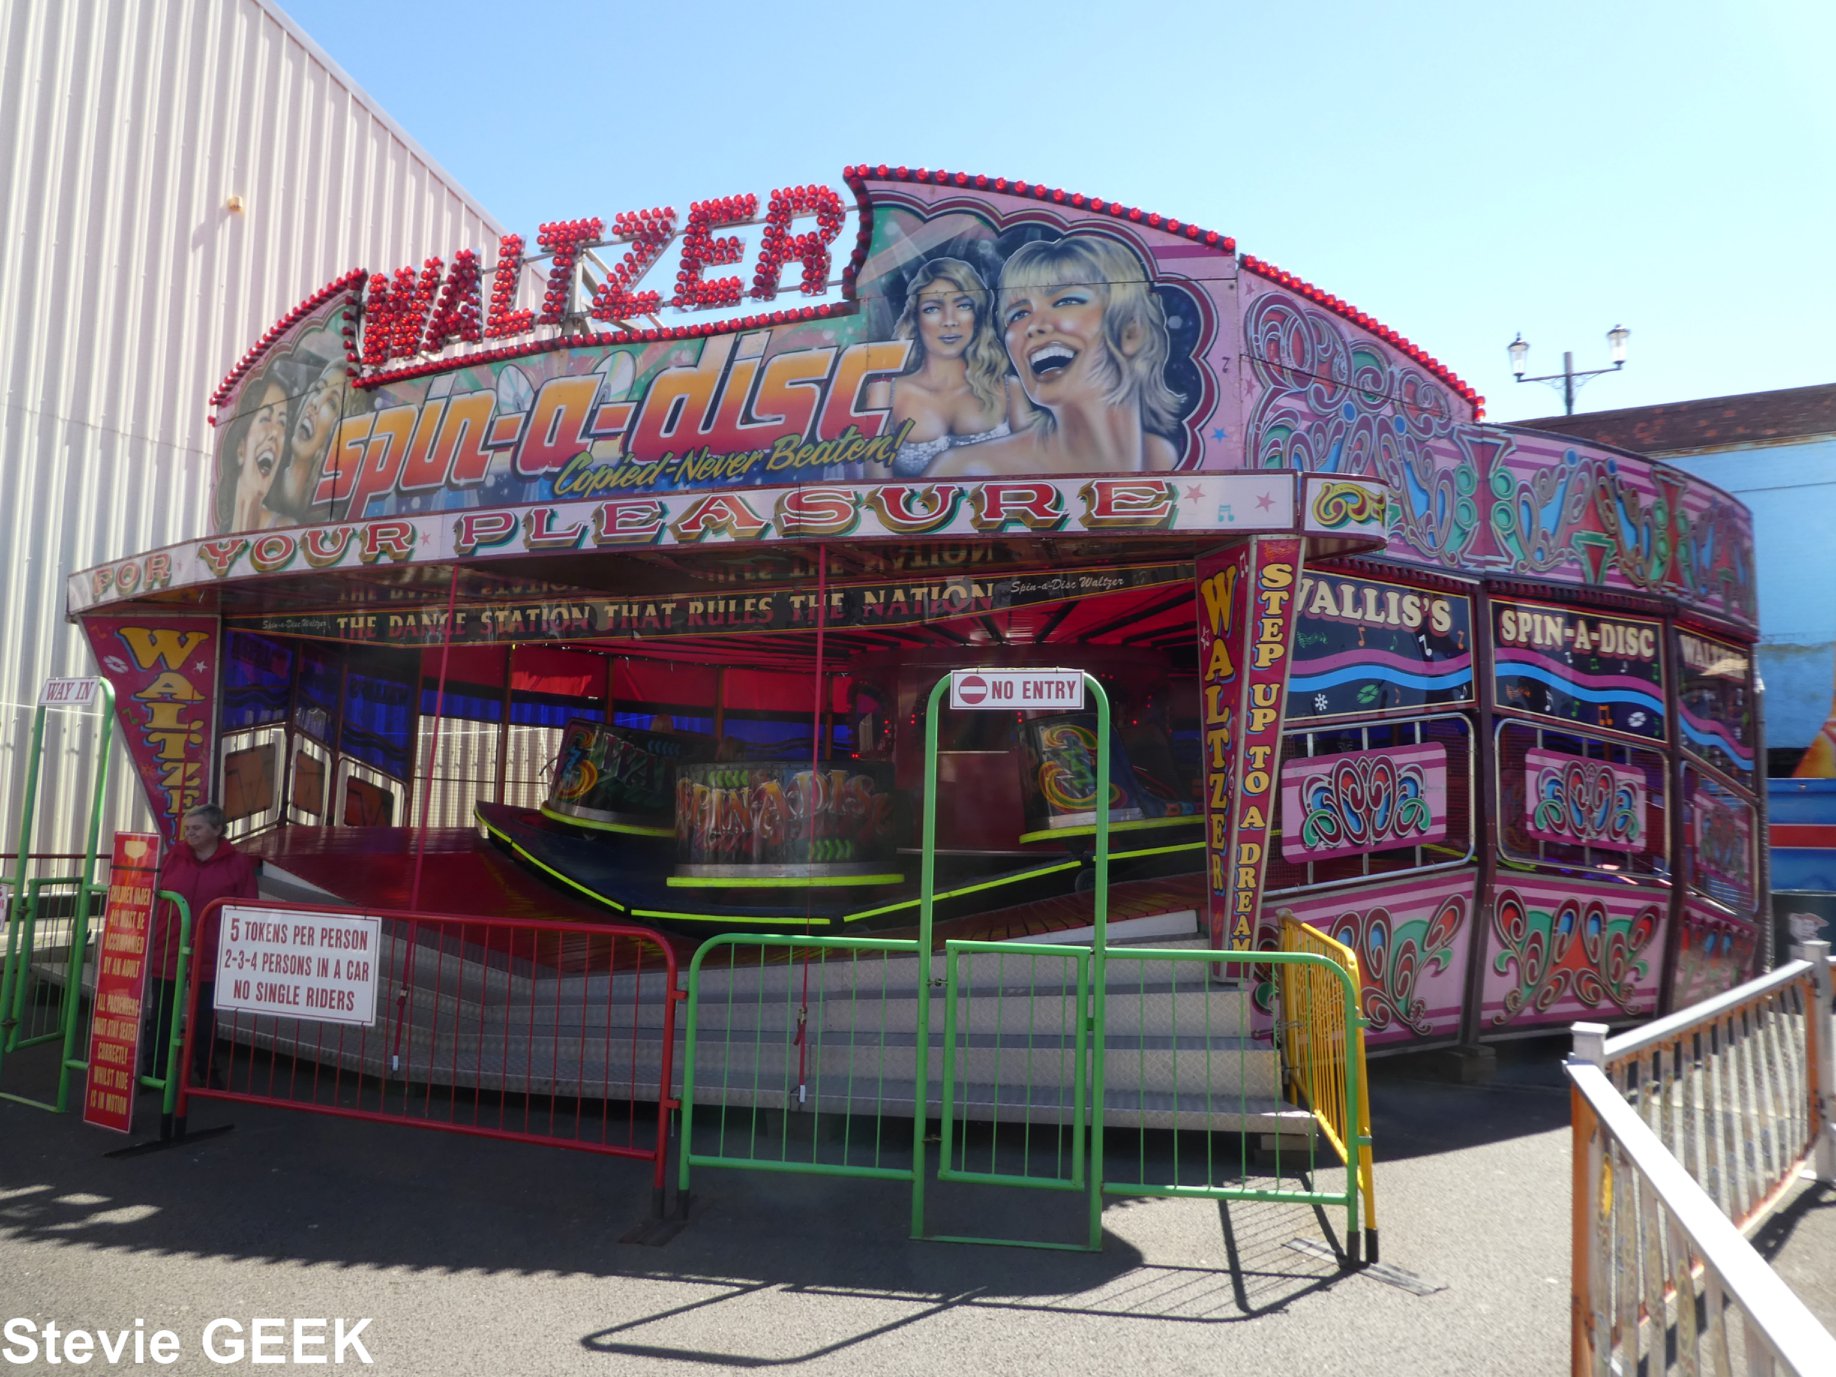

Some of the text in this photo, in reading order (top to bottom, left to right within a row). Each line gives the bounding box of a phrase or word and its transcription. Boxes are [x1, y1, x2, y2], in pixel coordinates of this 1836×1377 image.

[361, 184, 846, 366] WALTZER
[765, 418, 915, 471] Beaten!
[92, 477, 1181, 598] FOR YOUR PLEASURE
[337, 583, 994, 639] THE DANCE STATION THAT RULES THE NATION
[1010, 576, 1124, 595] Spin-a-Disc Waltzer
[1501, 608, 1656, 657] SPIN-A-DISC
[46, 681, 95, 700] WAY IN
[991, 680, 1077, 700] NO ENTRY
[115, 626, 210, 846] WALTZE
[1201, 564, 1237, 892] WALTZER
[1231, 563, 1293, 951] STEP UP TO A DREAM
[230, 917, 368, 951] 5 TOKENS PER PERSON
[224, 948, 370, 982] 2-3-4 PERSONS IN A CAR
[233, 979, 356, 1012] NO SINGLE RIDERS
